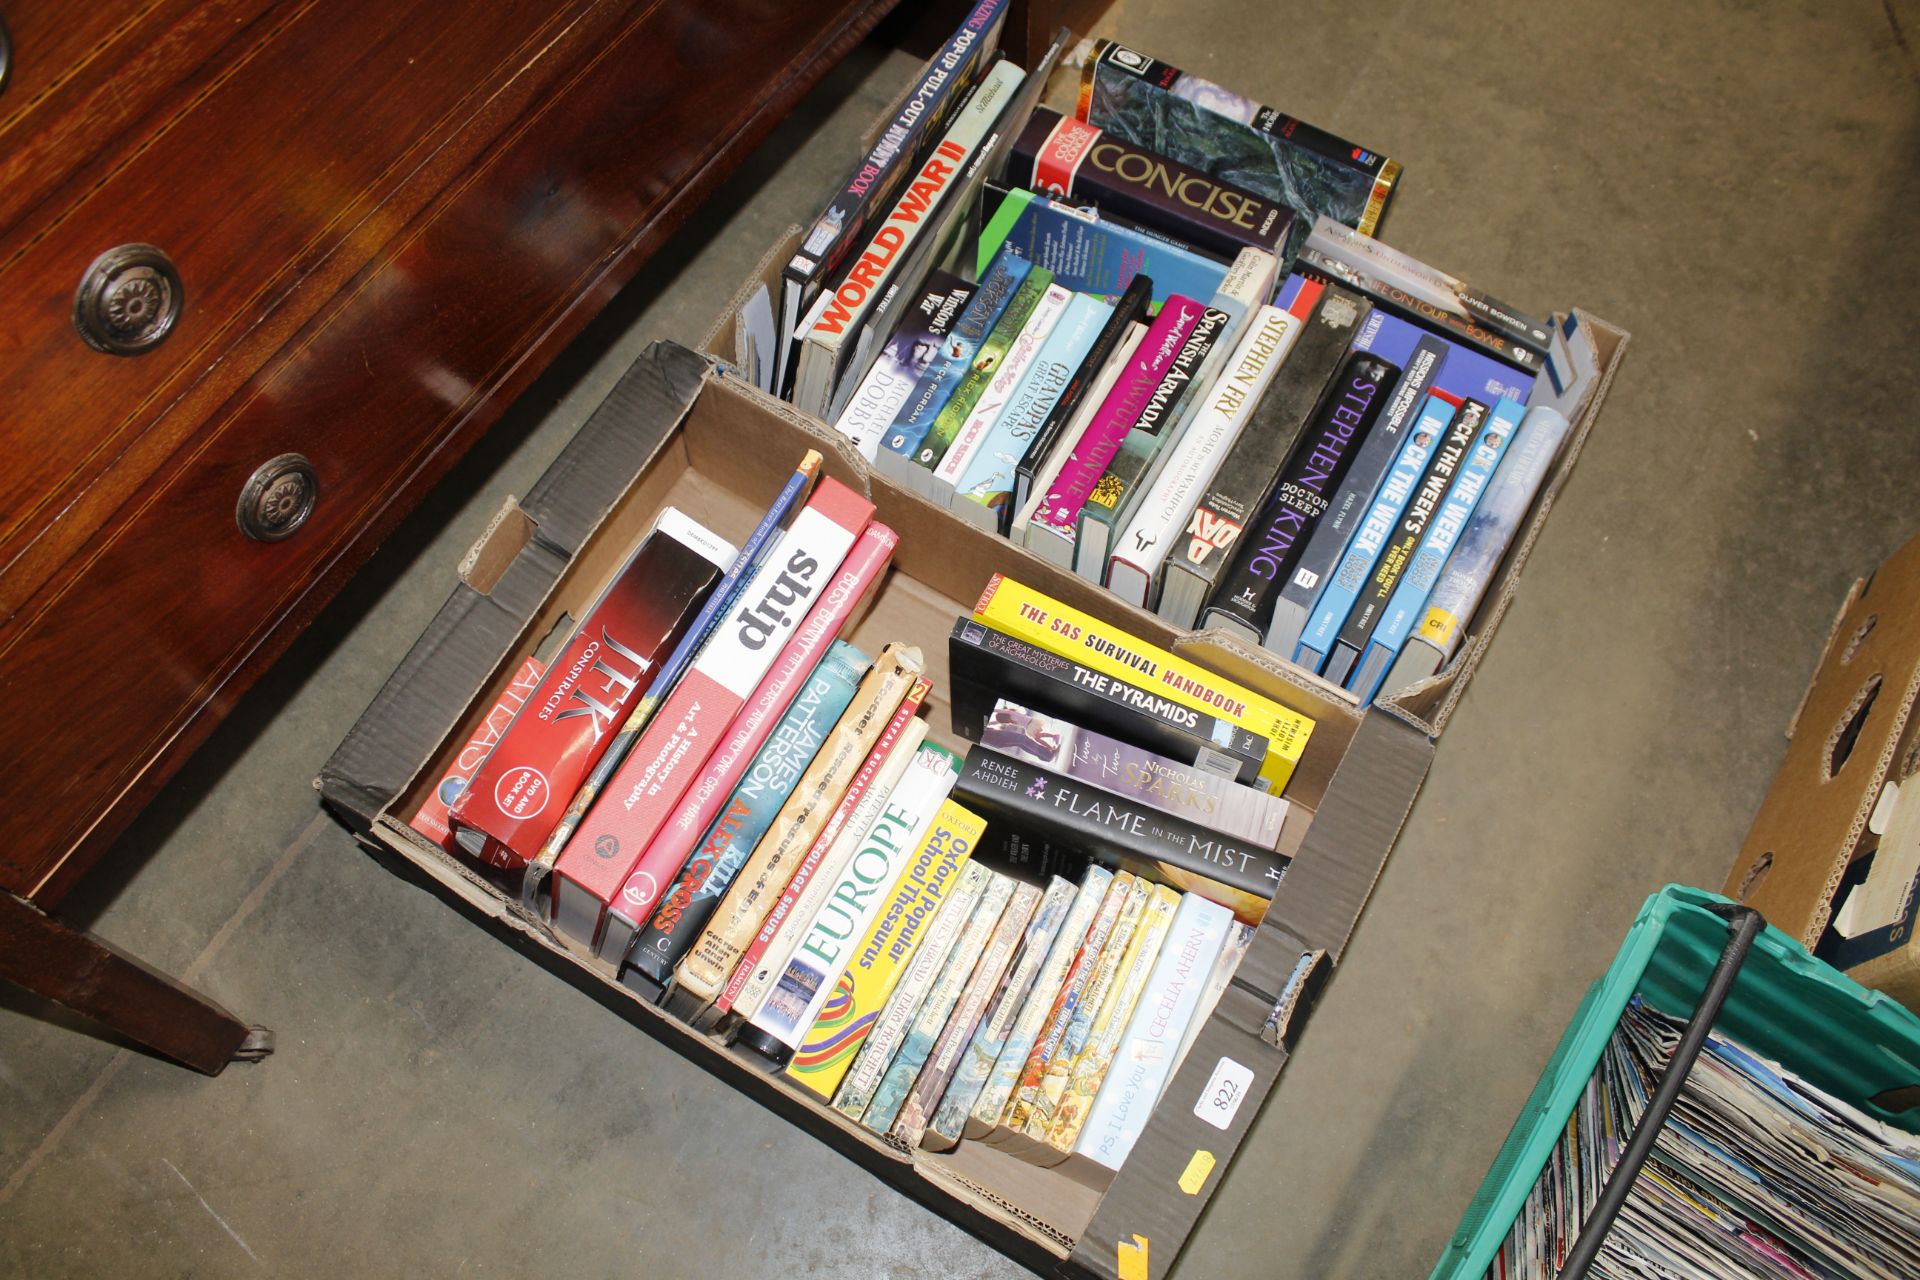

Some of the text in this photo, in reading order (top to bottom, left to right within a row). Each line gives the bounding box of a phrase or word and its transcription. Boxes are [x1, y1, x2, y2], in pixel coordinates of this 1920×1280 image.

[938, 25, 976, 70] POP-UP
[897, 65, 948, 128] PULL-OUT
[845, 161, 880, 200] BOOK
[1090, 143, 1263, 230] CONCISE
[812, 220, 910, 343] WORLD
[888, 151, 956, 233] WAR
[938, 136, 967, 164] II
[1258, 209, 1278, 237] INDEXED
[918, 289, 943, 317] War
[927, 283, 969, 339] Winston's
[1391, 287, 1505, 350] ON TOUR BOWIE
[1457, 291, 1528, 331] OLIVER BOWDEN
[1148, 304, 1197, 372] David Walliams
[1196, 340, 1211, 357] THE
[962, 372, 980, 395] RICK
[1025, 359, 1051, 393] GREAT
[1134, 305, 1228, 437] SPANISH ARMADA
[1211, 312, 1288, 422] STEPHEN FRY
[845, 368, 894, 432] DOBBS
[866, 377, 908, 438] MICHAEL
[907, 359, 951, 424] RICK RIORDAN
[1000, 390, 1031, 431] ESCAPE
[1009, 359, 1071, 445] GRANDPA'S
[1385, 351, 1436, 434] MISSIONS IMPOSSIBLE
[1200, 423, 1224, 455] MOAB
[1296, 375, 1379, 493] STEPHEN
[1278, 489, 1320, 520] SLEEP
[1280, 478, 1328, 513] DOCTOR
[1341, 491, 1356, 511] HAZEL
[1403, 442, 1462, 535] THE WEEK'S
[1452, 467, 1485, 506] THE
[1187, 508, 1243, 549] DAY
[1353, 466, 1414, 556] THE WEEK
[1425, 500, 1467, 555] WEEK
[1246, 505, 1306, 582] KING
[1374, 544, 1401, 584] EVER NEED
[1376, 535, 1415, 599] ONLY BOOK YOU'LL
[737, 547, 819, 651] ship
[975, 574, 1002, 615] COLLINS
[1429, 618, 1448, 634] CRI
[987, 639, 1056, 673] OF ARCHAEOLOGY
[991, 632, 1070, 671] THE GREAT MYSTERIES
[1018, 602, 1247, 718] THE SAS SURVIVAL HANDBOOK
[538, 641, 600, 722] CONSPIRACIES
[552, 625, 654, 745] JFK
[674, 570, 859, 831] BUGS BUNNY FIFTY YEARS AND ONLY ONE GREY HARE
[908, 684, 925, 703] 2
[1070, 665, 1199, 729] THE PYRAMIDS
[739, 672, 830, 803] PATTERSON
[1269, 717, 1281, 736] JOHN
[1281, 717, 1301, 752] WISEMAN
[621, 700, 702, 813] Art & Photography
[646, 725, 699, 798] A History in
[767, 716, 826, 797] JAMES
[971, 767, 1019, 792] AHDIEH
[979, 755, 1019, 778] RENÉE
[1068, 734, 1125, 782] Two Two
[1142, 759, 1207, 790] NICHOLAS
[501, 770, 530, 807] BOOK SET
[512, 777, 541, 814] DVD AND
[844, 781, 878, 830] ABSURD
[1117, 761, 1221, 814] SPARKS
[757, 707, 909, 944] STEFAN BUCZACKI FOLIAGE SHRUBS
[765, 797, 817, 874] Treasures
[851, 783, 890, 842] PATENTLY
[939, 810, 978, 836] OXFORD
[1050, 787, 1257, 875] FLAME IN THE MIST
[650, 795, 752, 937] ALEX CROSS
[699, 841, 746, 901] KILL
[800, 798, 920, 967] EUROPE
[857, 824, 952, 973] School Thesaurus
[882, 834, 969, 966] Oxford Popular
[693, 949, 725, 972] Unwin
[702, 947, 723, 962] and
[704, 929, 740, 954] George
[704, 938, 731, 958] Allen
[1081, 958, 1093, 971] OF
[1086, 949, 1098, 961] SIDE
[1089, 930, 1107, 952] DARK
[726, 963, 751, 998] HAMLYN
[1070, 979, 1084, 995] SUN
[1076, 968, 1089, 982] THE
[1081, 978, 1106, 1013] PRATCHETT
[1144, 977, 1188, 1039] CECELIA
[1170, 926, 1209, 979] AHERN
[925, 977, 956, 1026] Terry Pratchett
[1055, 1006, 1072, 1026] TERRY
[855, 990, 915, 1087] TERRY PRATCHETT
[936, 1023, 965, 1068] Terry Pratchett
[1039, 1023, 1066, 1059] PRATCHETT
[1107, 1063, 1148, 1130] I Love You
[1213, 1079, 1240, 1113] 822
